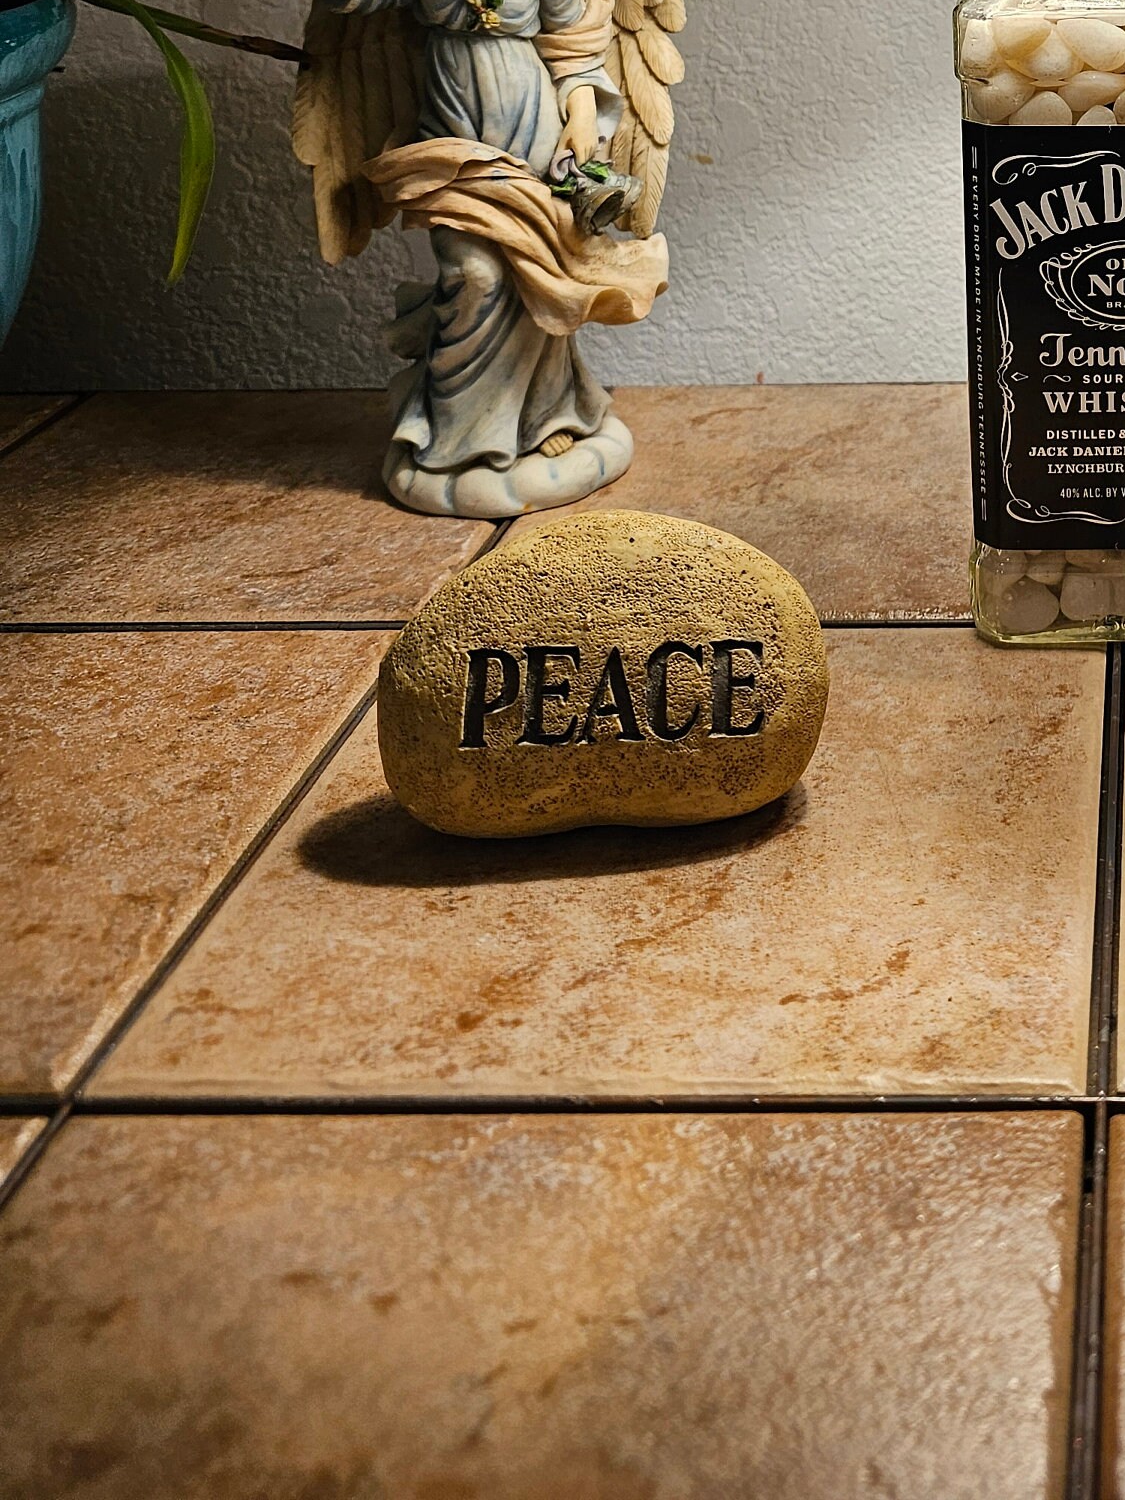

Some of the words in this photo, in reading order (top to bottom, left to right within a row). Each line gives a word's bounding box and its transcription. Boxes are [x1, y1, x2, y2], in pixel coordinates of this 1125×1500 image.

[972, 174, 980, 221] EVERY
[989, 181, 1099, 260] JACK
[974, 265, 982, 305] MADE
[975, 309, 982, 323] IN
[975, 327, 984, 410] LYNCHBURG
[1082, 374, 1125, 385] SOUR
[978, 414, 987, 495] TENNESSEE
[1028, 446, 1069, 457] JACK
[1046, 429, 1116, 440] DISTILLED
[1060, 488, 1080, 499] 40%
[1083, 487, 1103, 498] ALC.
[1106, 487, 1118, 498] BY
[458, 638, 765, 750] PEACE
